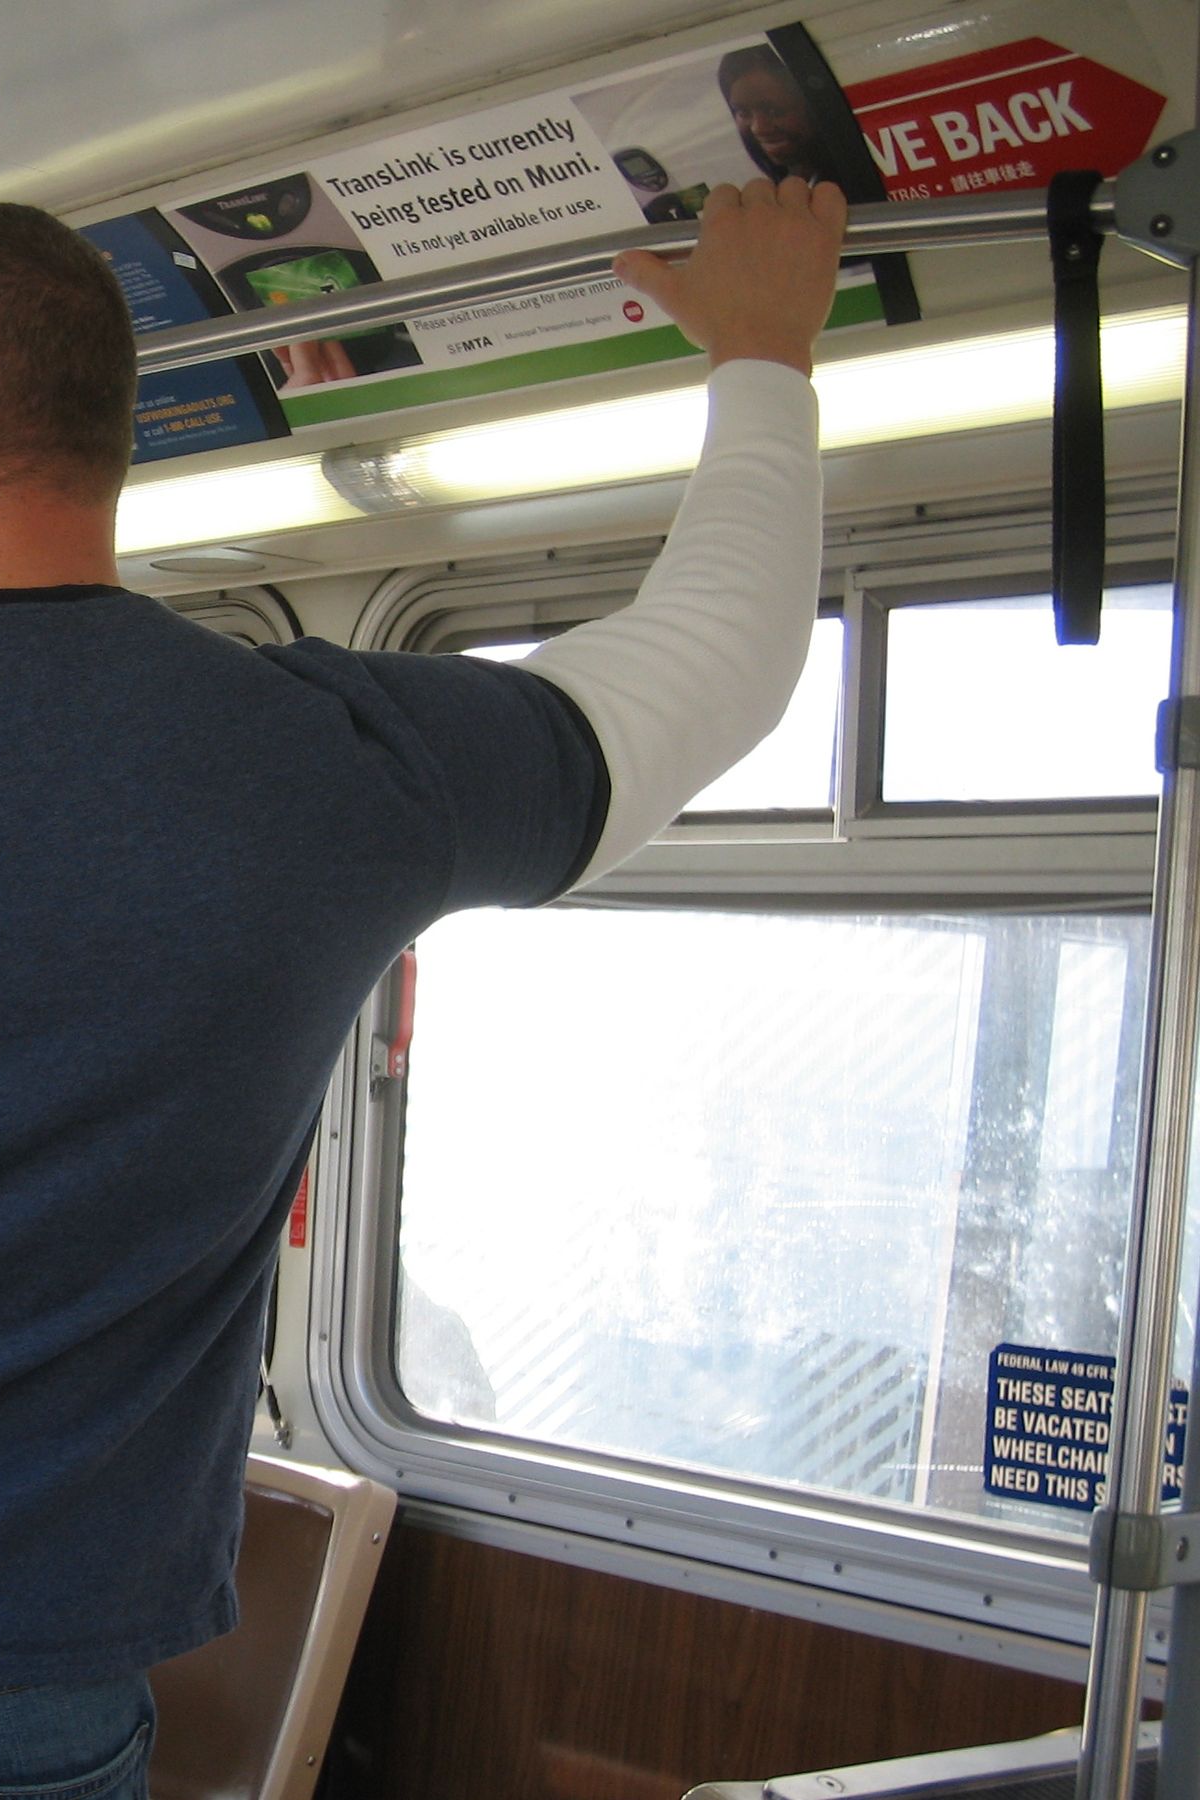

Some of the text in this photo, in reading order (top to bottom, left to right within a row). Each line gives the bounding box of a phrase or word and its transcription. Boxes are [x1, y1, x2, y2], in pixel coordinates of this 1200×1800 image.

[863, 81, 1092, 177] VE BACK
[327, 118, 577, 198] TransLink is currently
[352, 151, 601, 230] being tested on Muni.
[888, 184, 931, 202] TRAS
[391, 198, 602, 257] It is not yet available for use.
[413, 279, 625, 332] Please visit translink.org for more inform
[447, 335, 494, 355] SFMTA
[998, 1353, 1043, 1372] FEDERAL
[1045, 1359, 1069, 1375] LAW
[1071, 1362, 1085, 1377] 49
[1086, 1364, 1108, 1380] CFR
[997, 1377, 1056, 1408] THESE
[994, 1406, 1110, 1446] BE VACATED
[990, 1464, 1040, 1495] NEED
[1045, 1473, 1089, 1503] THIS
